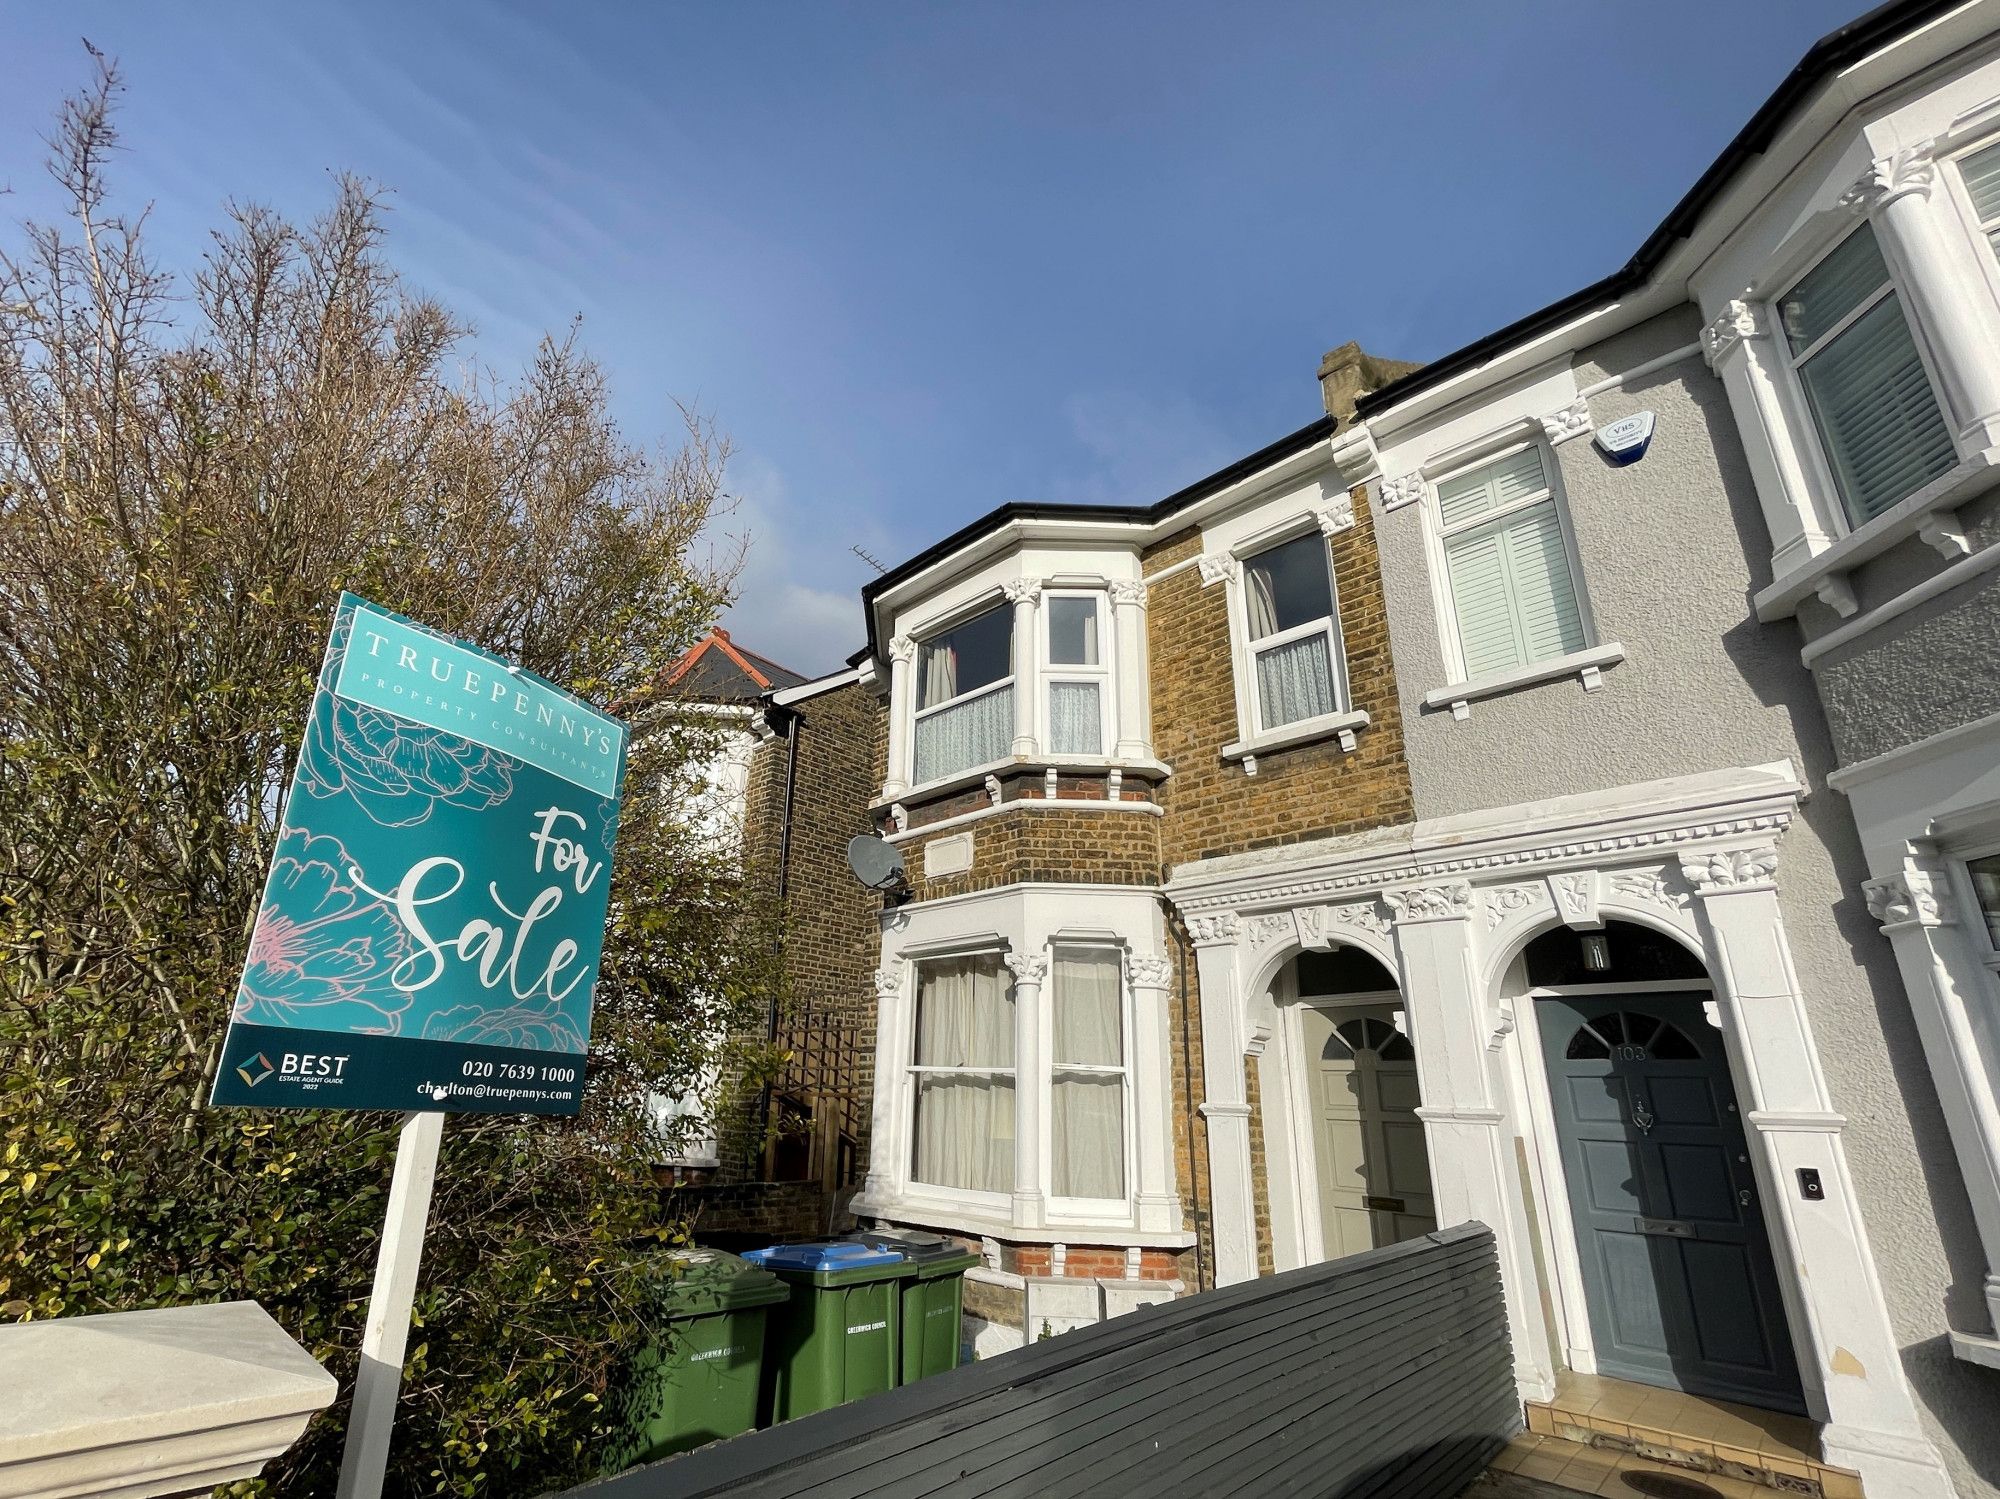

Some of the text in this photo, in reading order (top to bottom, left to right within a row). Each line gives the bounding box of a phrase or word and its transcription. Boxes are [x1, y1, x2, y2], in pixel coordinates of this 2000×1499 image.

[365, 630, 611, 756] TRUEPENNY'S
[361, 672, 606, 779] PROPERTY CONSULTANTS
[529, 806, 602, 894] For
[348, 856, 589, 1001] Sale
[278, 1075, 344, 1085] ESTATE AGENT GUIDE
[281, 1053, 349, 1076] BEST
[462, 1060, 576, 1083] 020 7639 1000
[1617, 1046, 1646, 1061] 103
